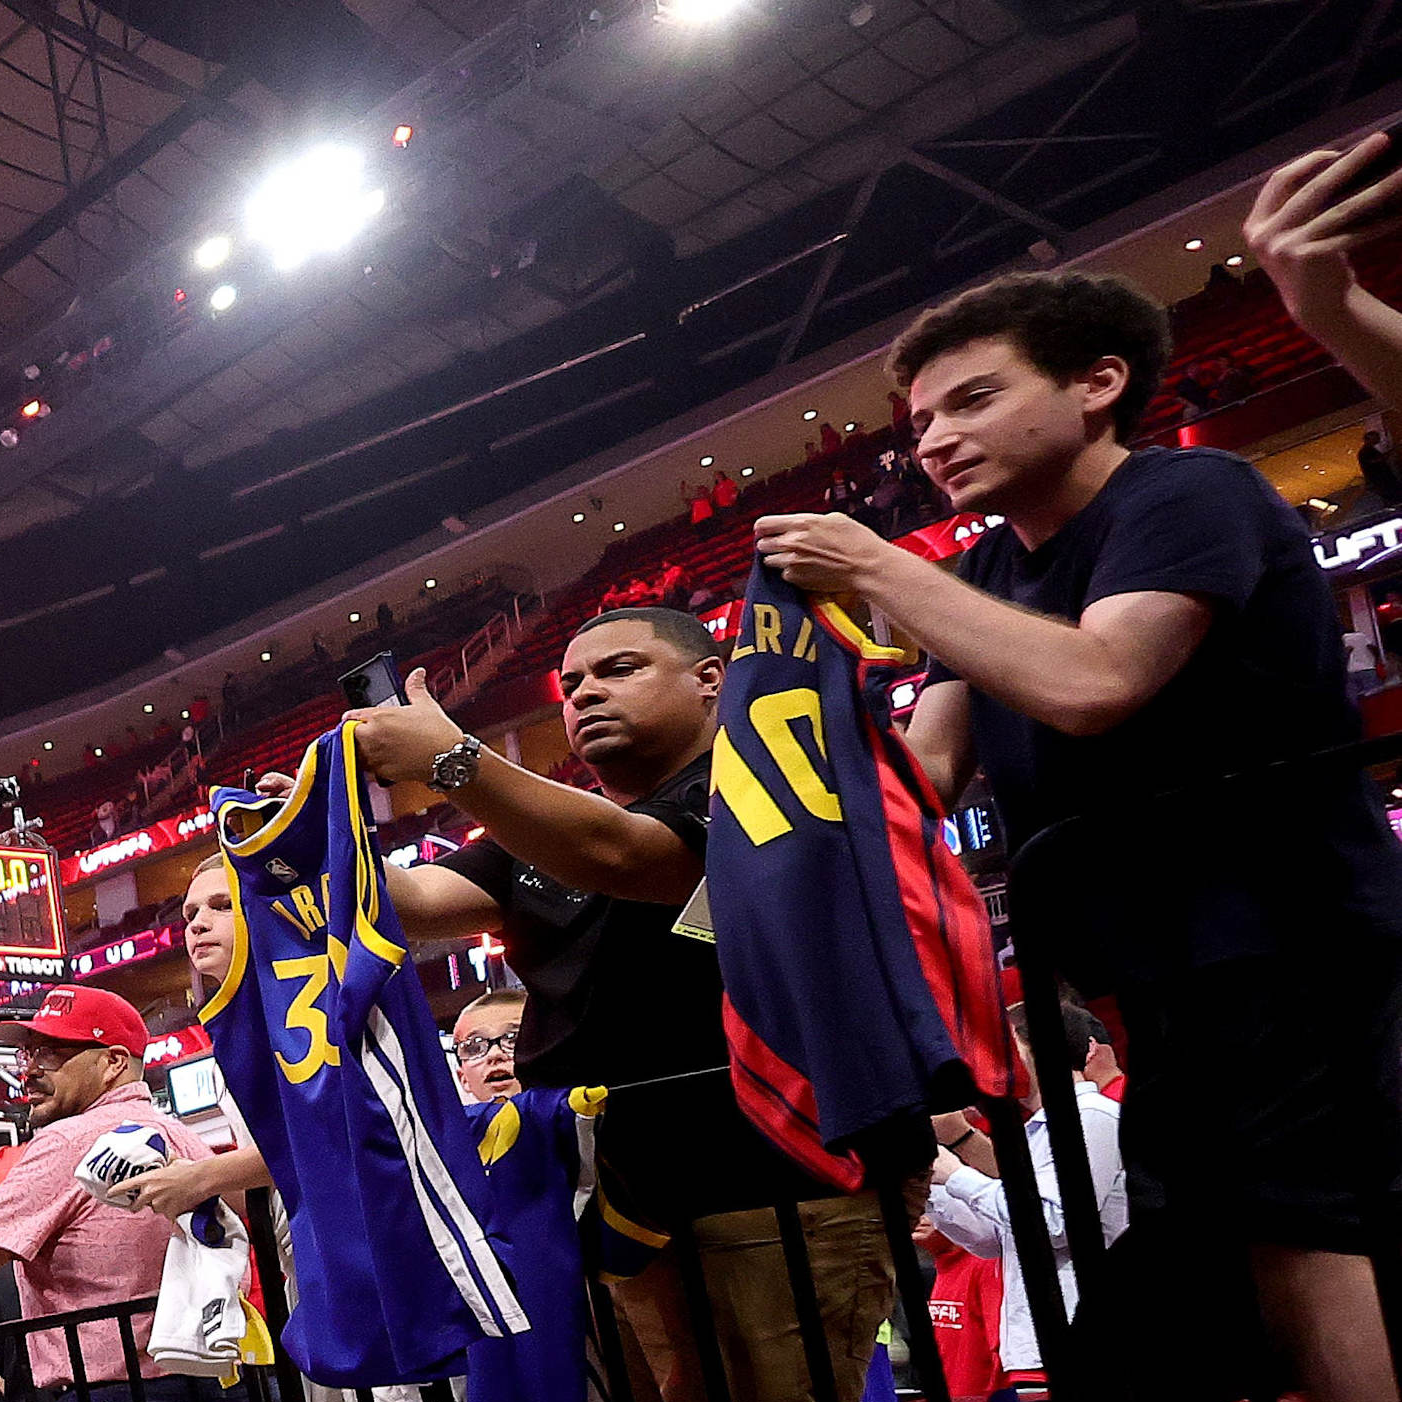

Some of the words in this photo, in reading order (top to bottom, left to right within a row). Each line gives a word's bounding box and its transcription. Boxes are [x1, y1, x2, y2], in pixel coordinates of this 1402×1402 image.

[1313, 518, 1402, 569] LIFT
[709, 688, 844, 847] 10
[4, 956, 65, 977] TISSOT
[106, 940, 135, 964] US
